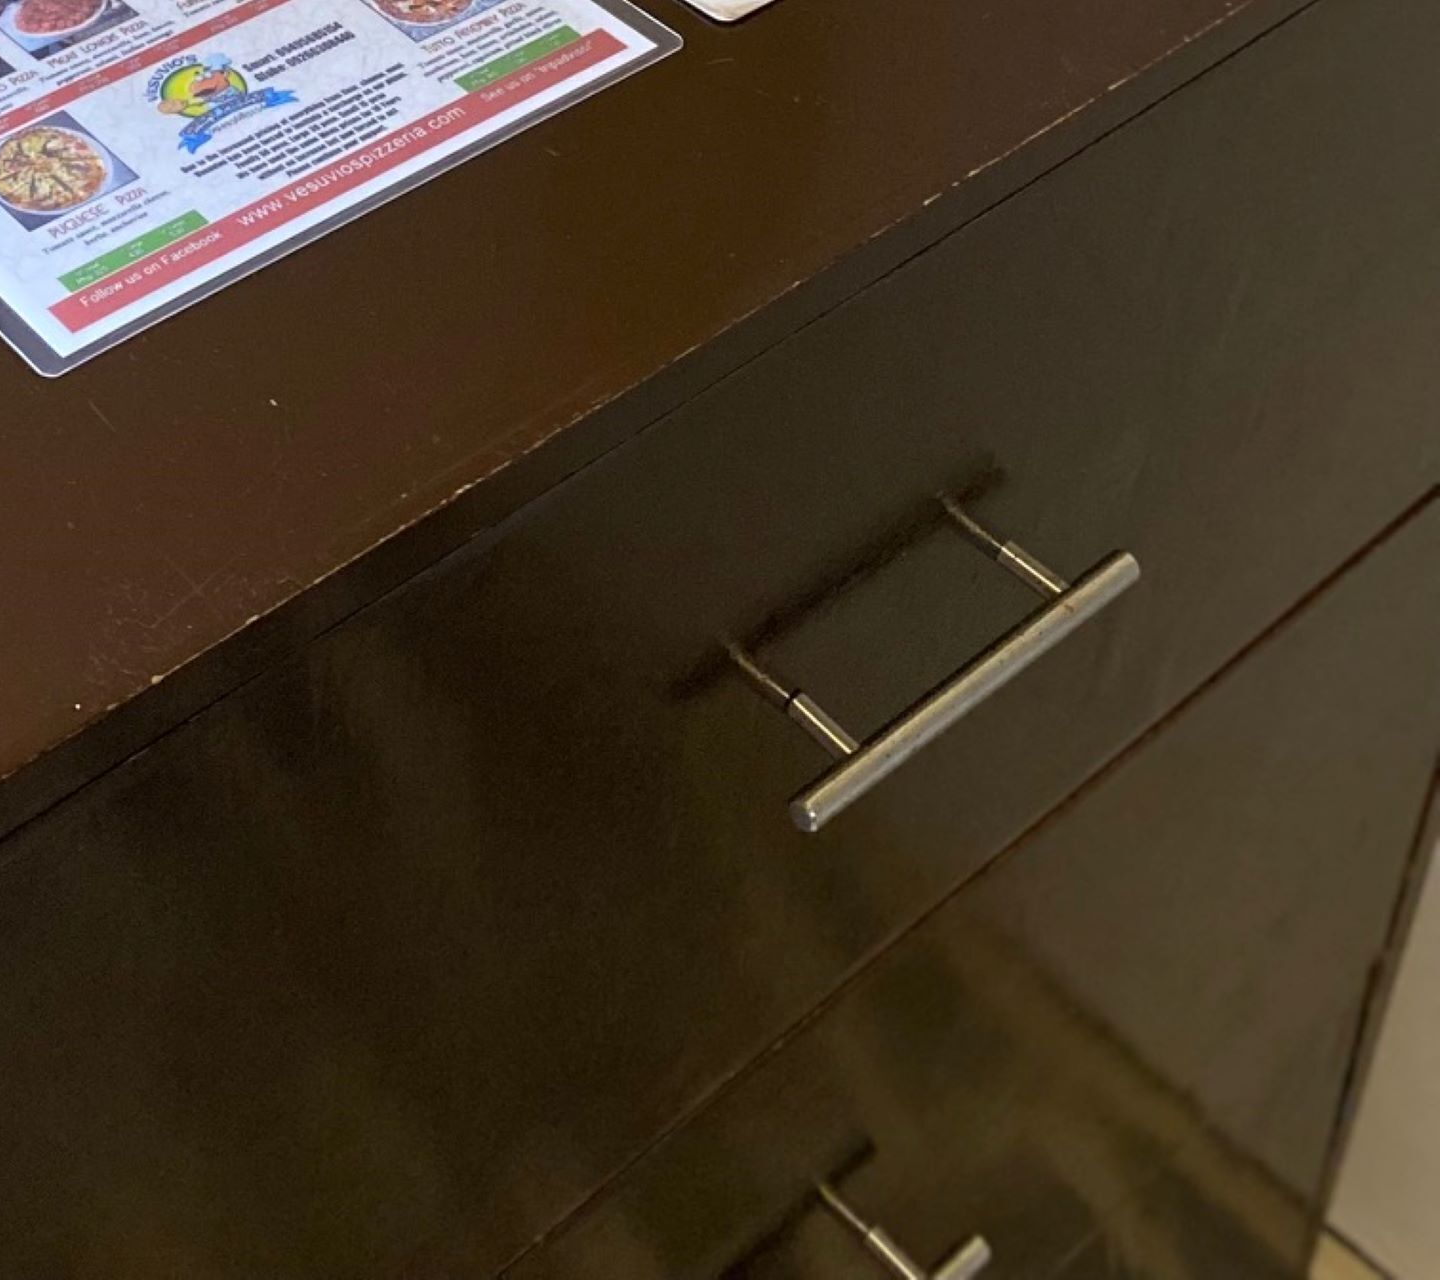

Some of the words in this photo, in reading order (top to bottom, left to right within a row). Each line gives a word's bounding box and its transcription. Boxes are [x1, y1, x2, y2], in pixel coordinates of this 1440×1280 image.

[118, 20, 148, 35] PIZZA
[7, 70, 38, 85] PIZZA
[144, 53, 198, 103] VESUVIO'S
[480, 87, 504, 101] See
[114, 187, 147, 205] PIZZA
[79, 281, 123, 306] Follow
[124, 272, 142, 284] us
[142, 262, 161, 274] on
[159, 232, 221, 264] Facebook
